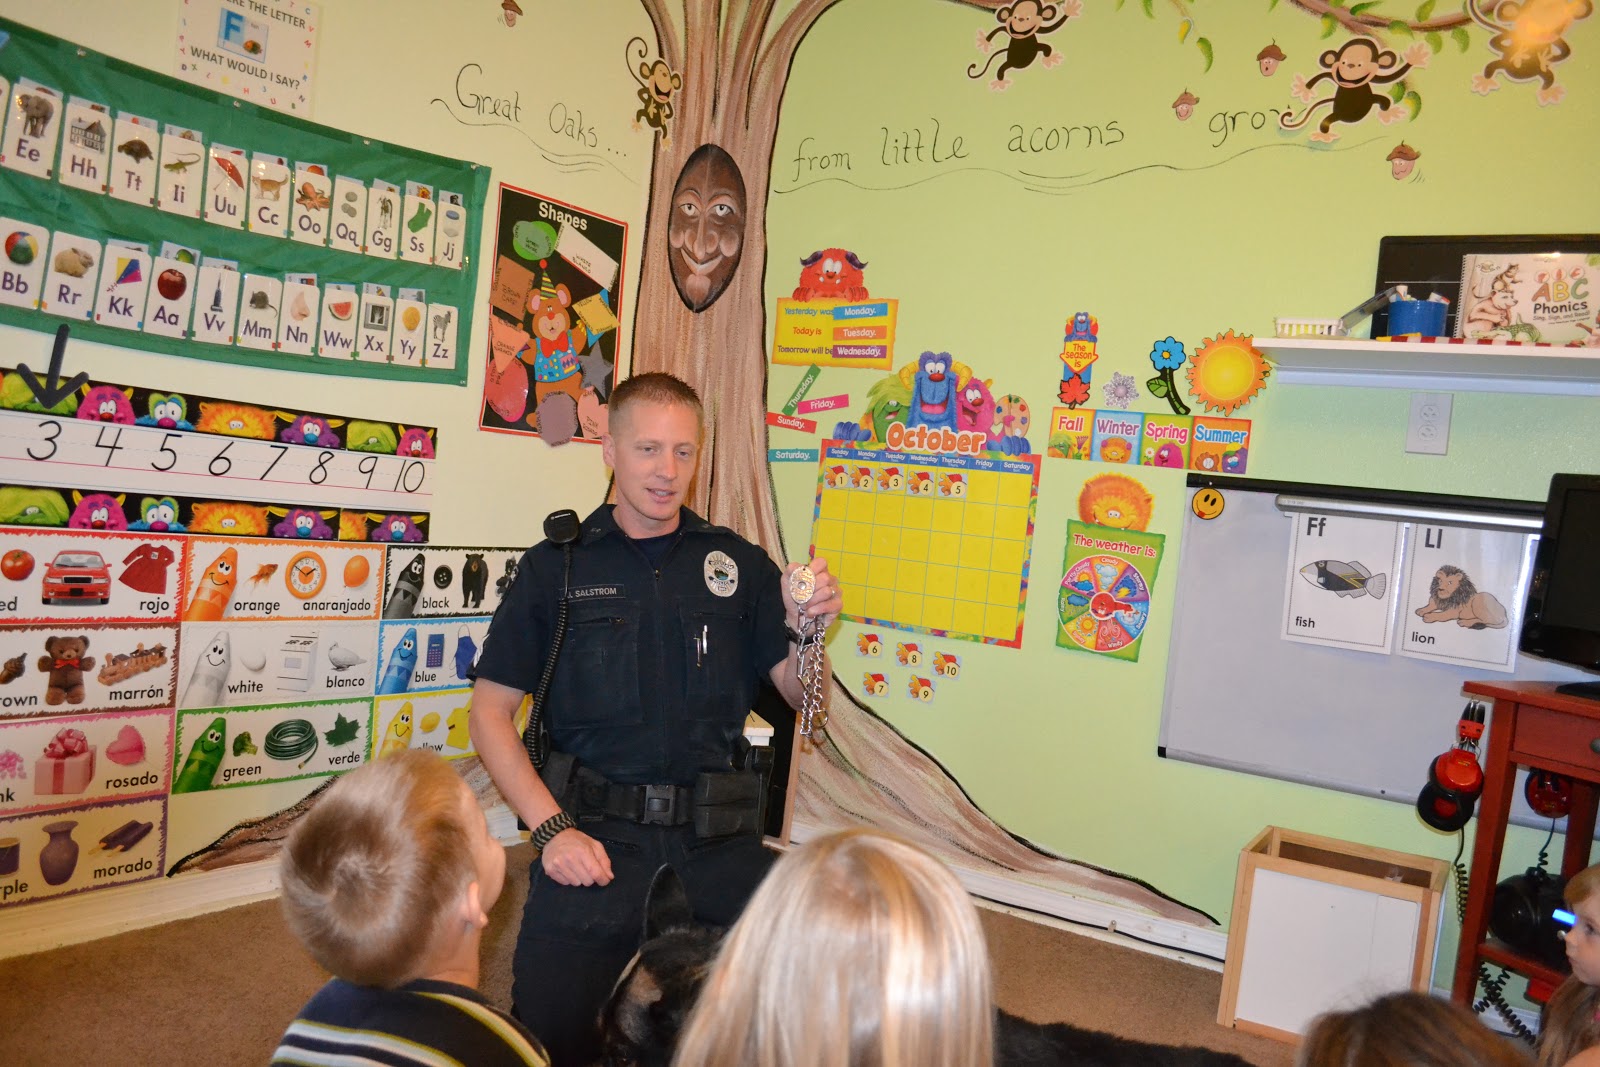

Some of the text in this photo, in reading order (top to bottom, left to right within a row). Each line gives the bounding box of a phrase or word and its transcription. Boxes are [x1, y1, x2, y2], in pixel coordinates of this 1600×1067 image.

[247, 0, 268, 16] THE
[270, 8, 306, 29] LETTER
[224, 10, 244, 41] F
[190, 45, 224, 66] WHAT
[227, 57, 268, 79] WOULD
[270, 72, 274, 82] I
[275, 74, 300, 90] SAY?
[456, 63, 521, 122] Great
[793, 137, 851, 182] from
[881, 118, 970, 166] little
[1008, 120, 1125, 154] acorns
[16, 138, 456, 261] Ee Hh Tt Ii Uu Cc Oo Qq Gg Ss Jj
[538, 201, 588, 231] Shapes
[1531, 278, 1589, 302] ABC
[1, 271, 449, 360] Bb Rr Kk Aa Vv Mm Nn Ww Xx Yy Zz
[785, 307, 818, 316] Yesterday
[844, 307, 876, 316] Monday.
[1533, 301, 1588, 314] Phonics
[793, 327, 814, 336] Today
[843, 328, 876, 337] Tuesday.
[777, 345, 809, 353] Tomorrow
[811, 346, 823, 354] will
[837, 347, 881, 357] Wednesday.
[1065, 351, 1093, 360] season
[1072, 343, 1086, 352] The
[1074, 360, 1081, 368] is
[788, 374, 814, 408] Thursday.
[810, 399, 836, 410] Friday.
[777, 415, 805, 428] Sunday.
[1058, 416, 1248, 445] Fall Winter Spring Summer
[887, 423, 985, 454] October
[27, 420, 425, 493] 3 4 5 6 7 8 9 10
[775, 451, 811, 460] Saturday.
[831, 448, 849, 456] Sunday
[857, 450, 877, 458] Monday
[885, 452, 906, 460] Tuesday
[910, 455, 939, 463] Wednesday
[942, 457, 967, 465] Thursday
[975, 459, 993, 468] Friday
[1003, 462, 1031, 470] Saturday
[863, 479, 869, 487] 2
[893, 478, 899, 487] 3
[923, 484, 929, 492] 4
[955, 485, 961, 494] 5
[1306, 517, 1327, 537] Ff
[1073, 534, 1156, 557] The weather is:
[1424, 528, 1443, 549] Ll
[575, 587, 617, 598] SALSTROM
[140, 597, 170, 614] rojo
[234, 598, 371, 615] orange anaranjado
[422, 597, 450, 609] black
[1295, 616, 1315, 629] fish
[1411, 631, 1435, 645] lion
[872, 645, 957, 675] 6 8 10
[227, 676, 365, 693] white blanco
[414, 671, 437, 682] blue
[109, 685, 164, 701] marrón
[878, 685, 929, 698] 7 9
[223, 751, 360, 781] green verde
[105, 771, 158, 790] rosado
[93, 858, 153, 879] morado
